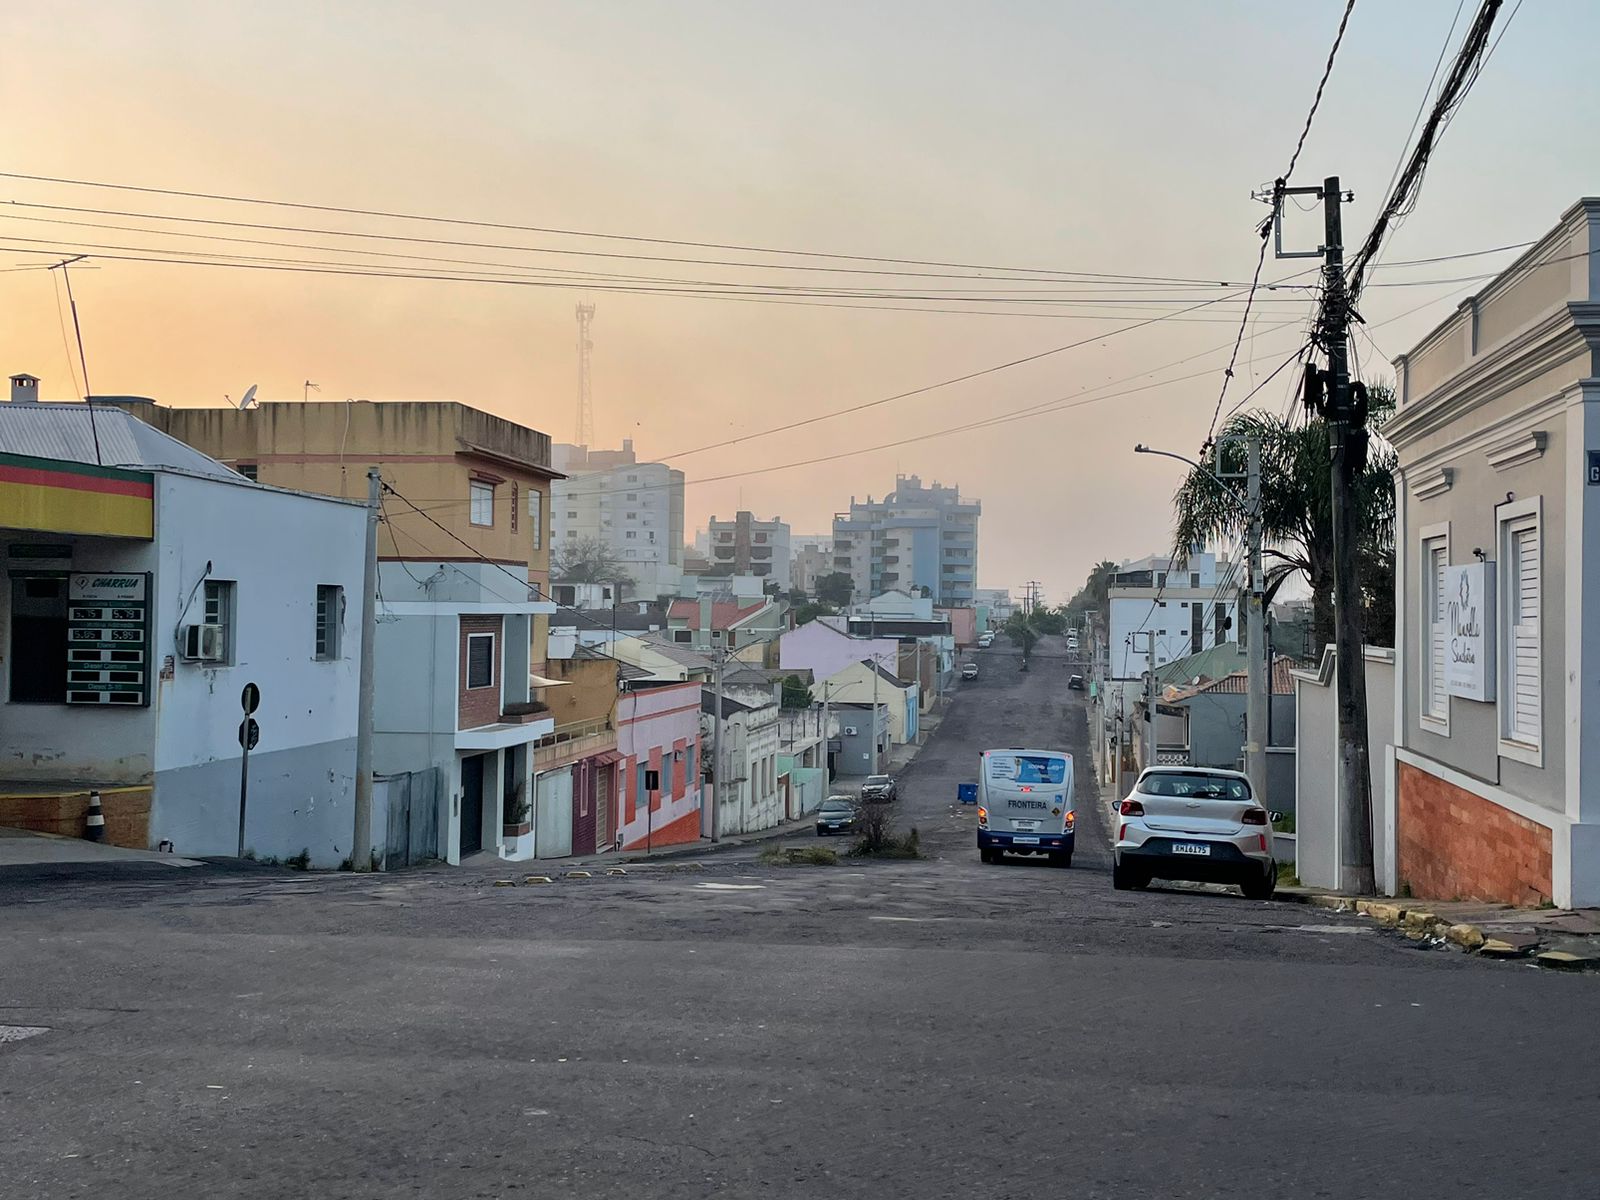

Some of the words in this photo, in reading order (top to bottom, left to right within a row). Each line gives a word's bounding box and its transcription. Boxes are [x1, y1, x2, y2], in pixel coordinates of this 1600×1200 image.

[92, 578, 138, 588] CHARRUA
[113, 609, 134, 618] 5.79
[1008, 800, 1047, 809] FRONTEIRA
